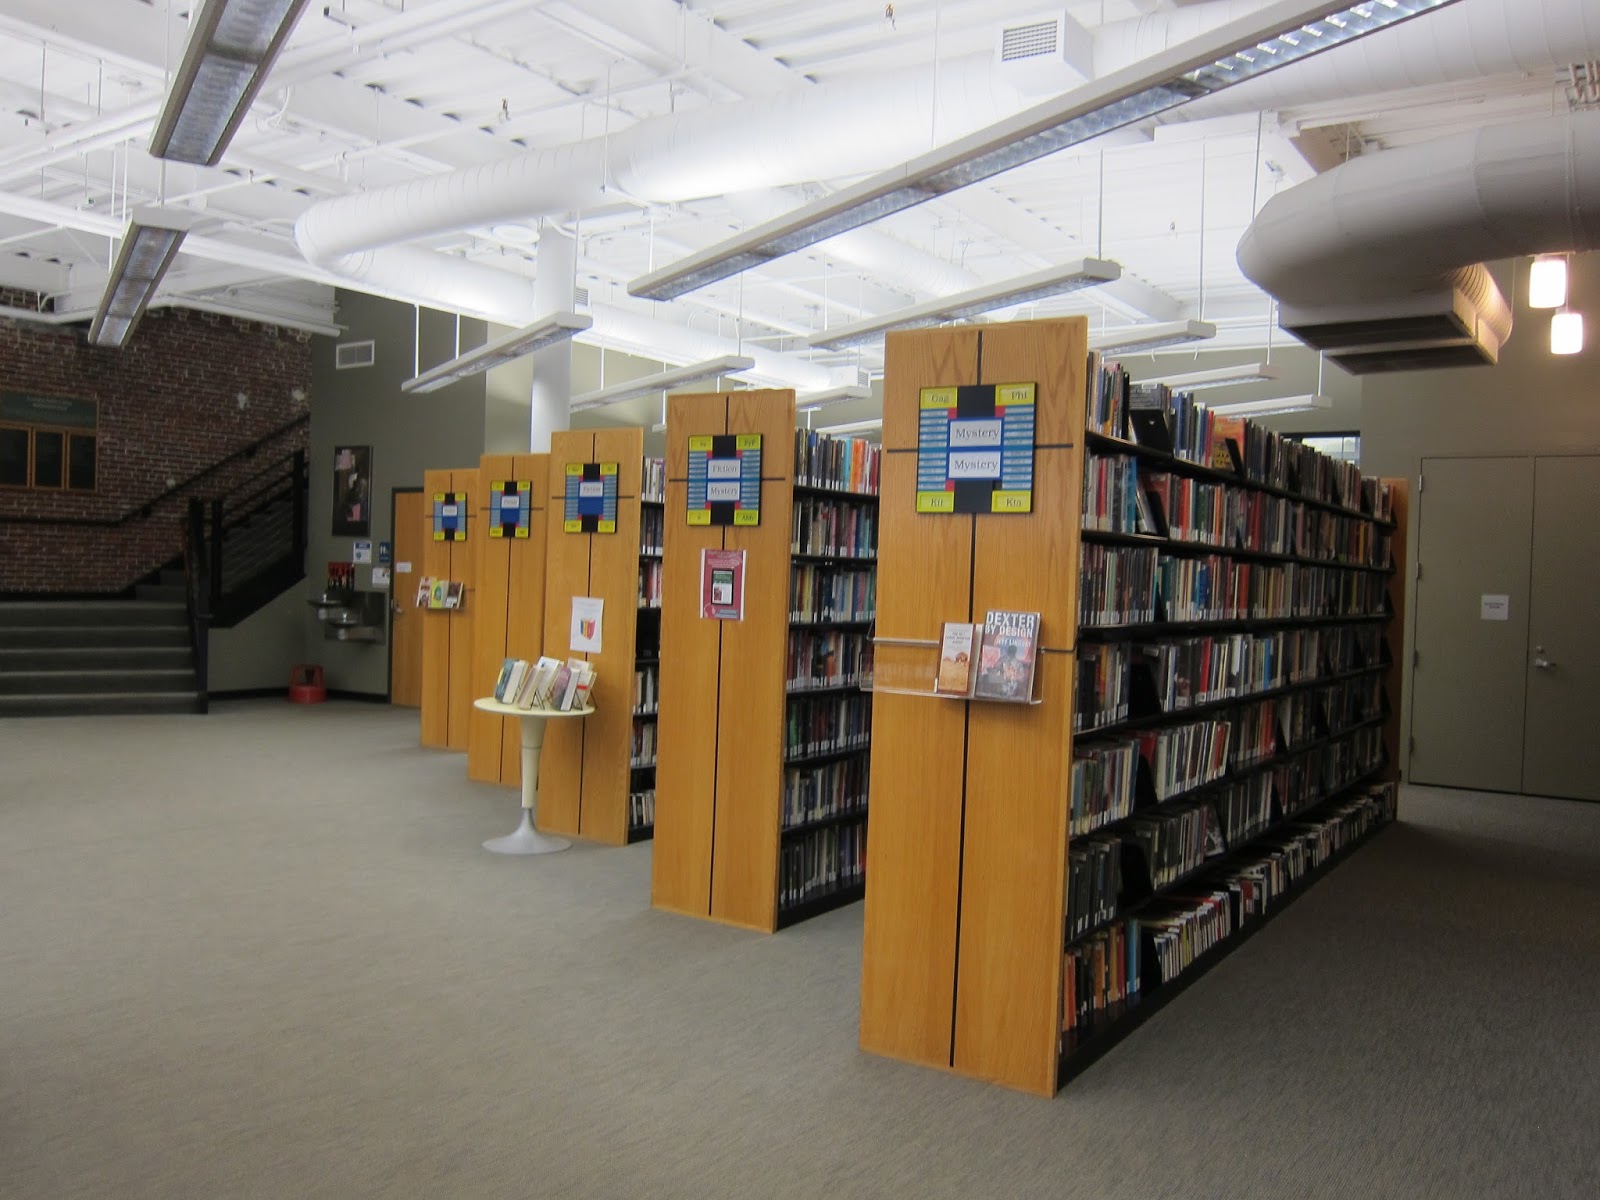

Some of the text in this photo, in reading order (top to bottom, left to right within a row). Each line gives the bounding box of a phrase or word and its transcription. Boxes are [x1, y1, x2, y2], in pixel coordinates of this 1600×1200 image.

[955, 427, 1000, 439] Mystery
[712, 464, 737, 473] Fiction
[954, 459, 998, 472] Mystery
[710, 486, 738, 496] Mystery
[986, 611, 1035, 629] DEXTER
[984, 624, 1033, 639] BY DESIGN
